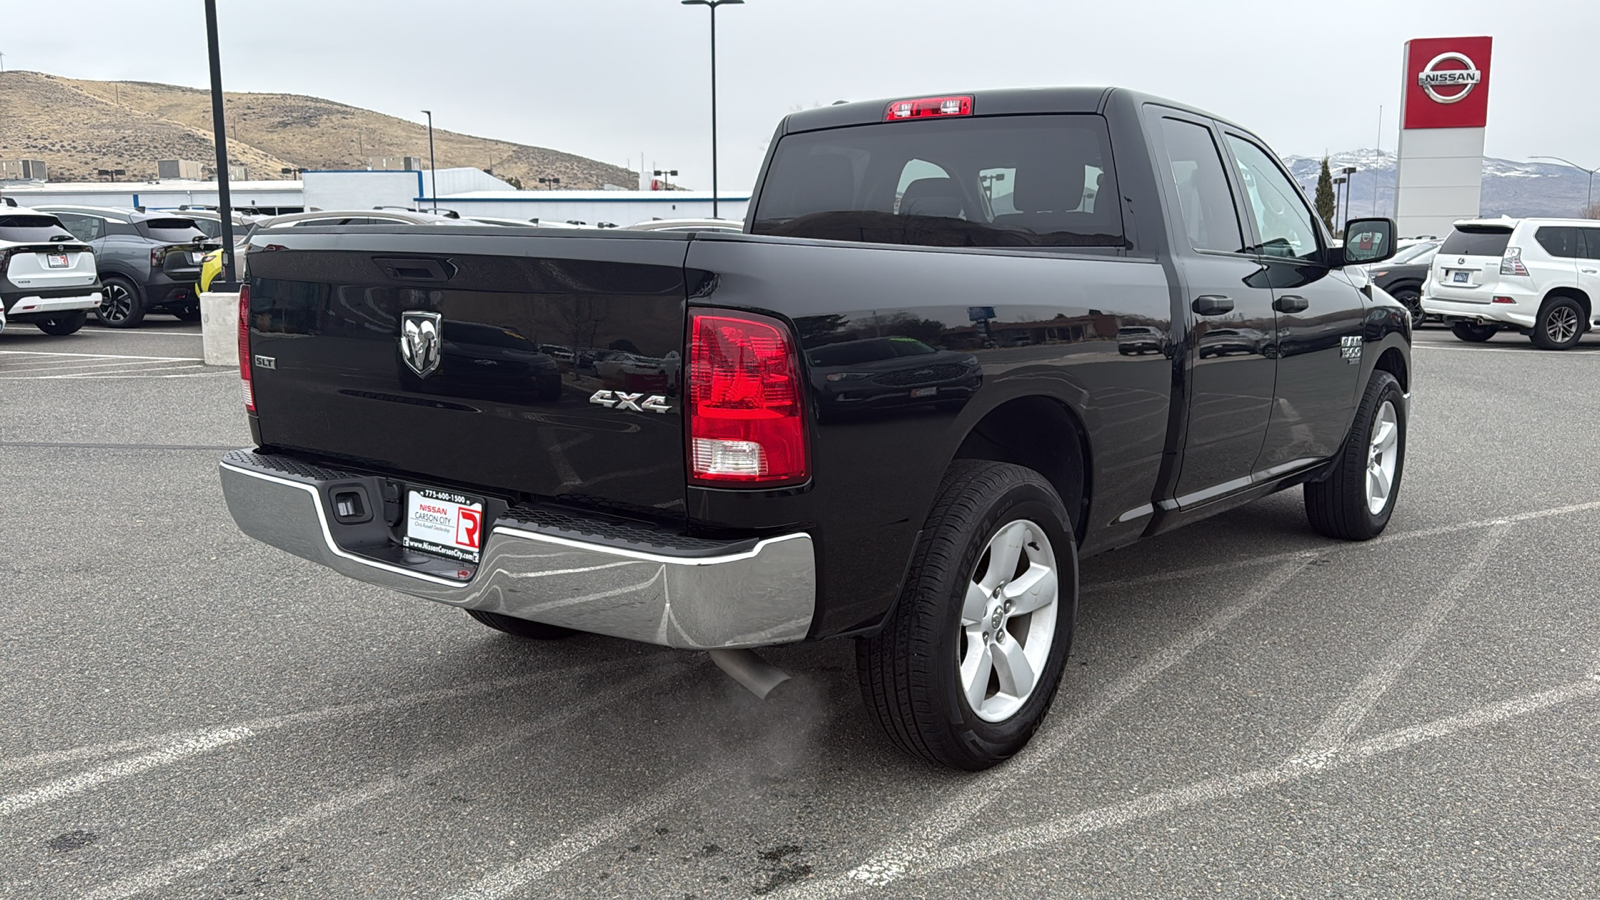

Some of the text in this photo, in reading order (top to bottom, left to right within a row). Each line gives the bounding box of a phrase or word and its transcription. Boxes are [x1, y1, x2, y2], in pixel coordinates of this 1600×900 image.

[1425, 73, 1475, 82] NISSAN
[255, 356, 275, 369] SLT
[425, 489, 466, 504] 775-600-1500
[419, 503, 448, 516] NISSAN
[414, 511, 452, 526] CARSON CITY
[409, 539, 474, 560] www.NissanCarsonCity.com
